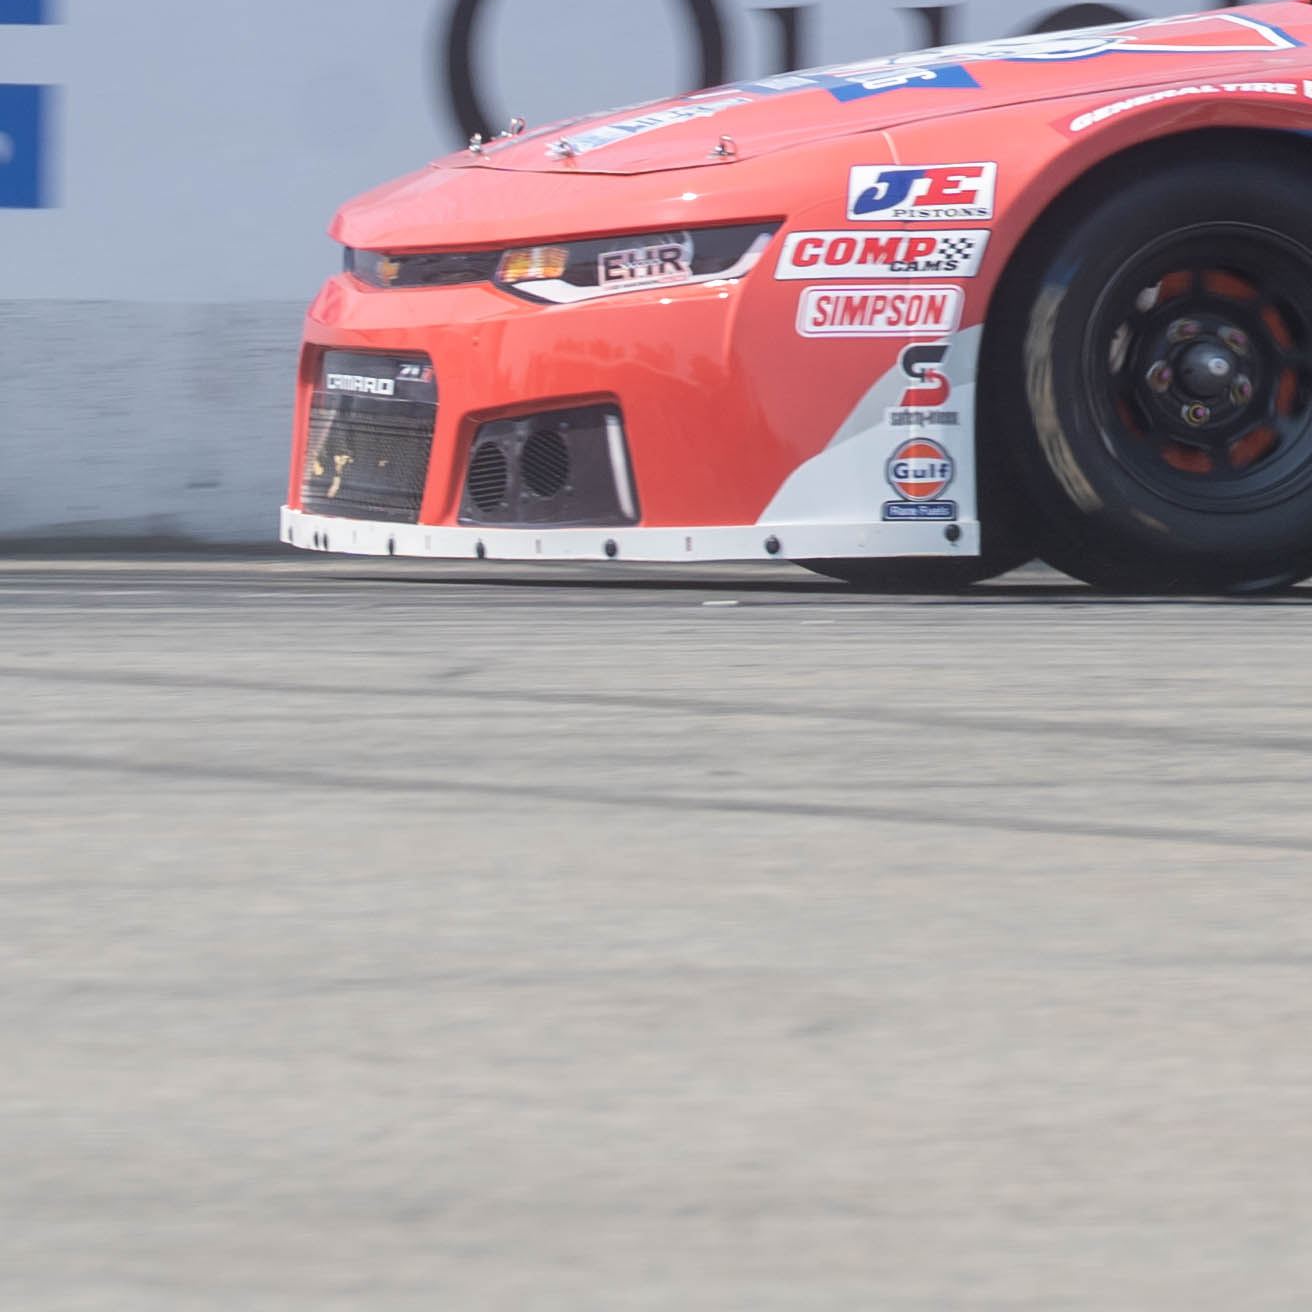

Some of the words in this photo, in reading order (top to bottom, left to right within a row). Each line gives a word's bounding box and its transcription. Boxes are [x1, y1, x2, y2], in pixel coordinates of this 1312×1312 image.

[1069, 82, 1219, 133] GENERAL
[1219, 81, 1298, 95] TIRE
[852, 165, 984, 215] JE
[891, 207, 989, 218] PISTONS
[603, 247, 684, 281] EHR
[791, 237, 937, 268] COMP
[889, 259, 960, 272] CAMS
[812, 293, 948, 327] SIMPSON
[893, 462, 950, 479] Gulf
